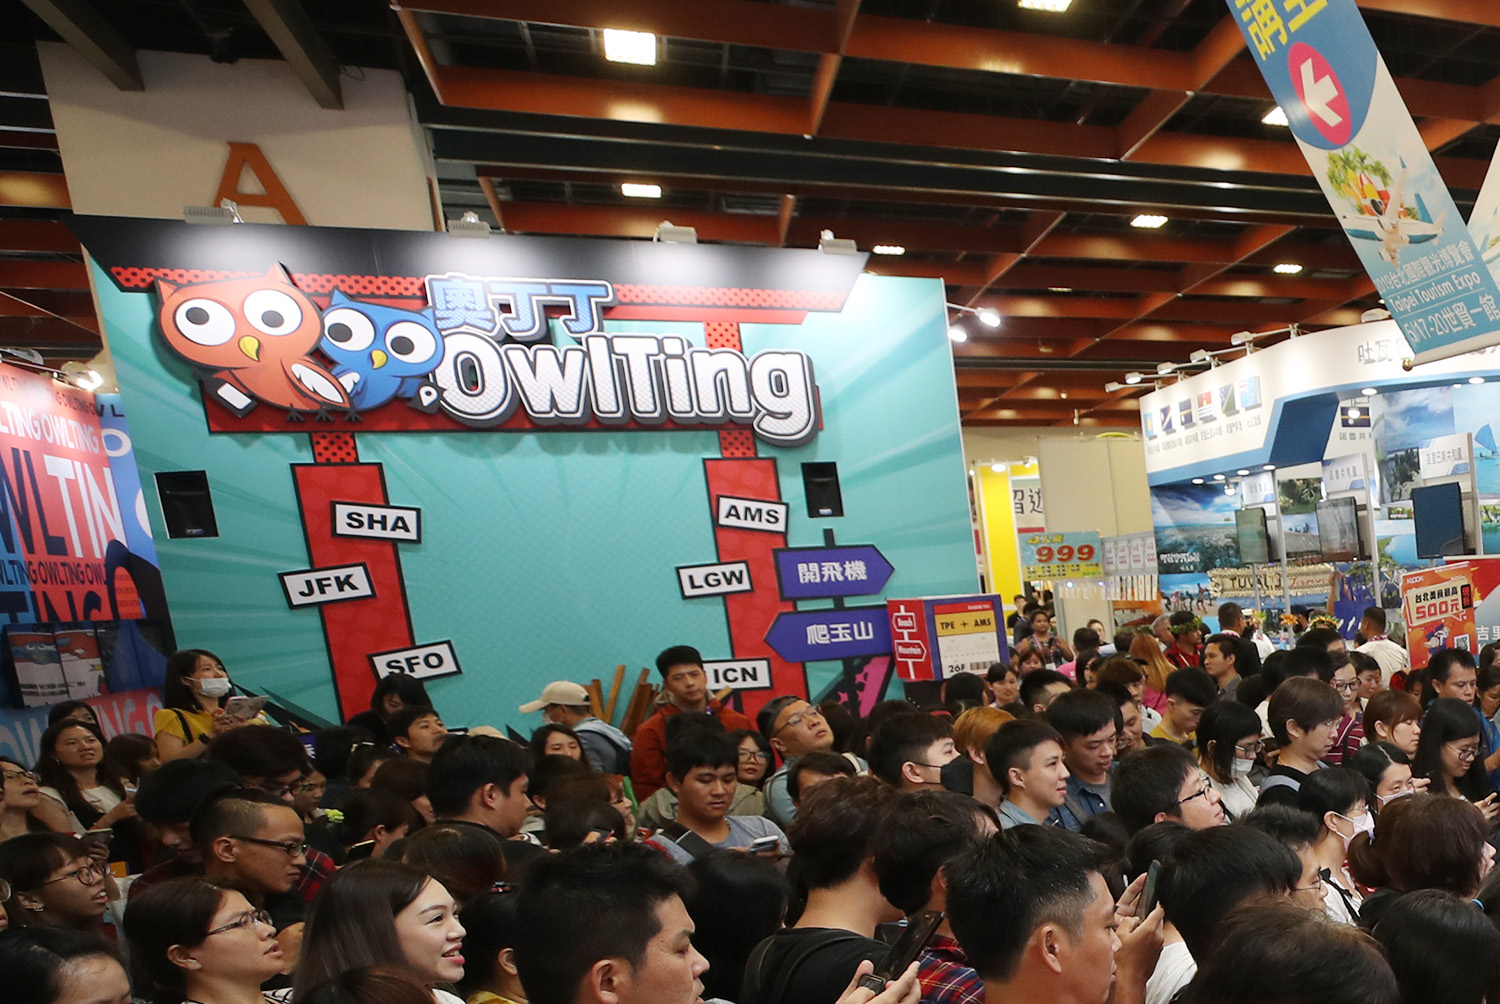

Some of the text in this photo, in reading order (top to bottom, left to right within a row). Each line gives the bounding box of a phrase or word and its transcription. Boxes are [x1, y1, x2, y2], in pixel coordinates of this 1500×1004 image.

[213, 143, 308, 225] A
[1388, 290, 1419, 313] Taipei
[1415, 281, 1455, 304] Tourism
[1451, 270, 1481, 291] Expo
[431, 278, 614, 336] 奧丁丁
[438, 328, 817, 444] OwlTing
[345, 510, 411, 534] SHA
[724, 504, 781, 526] AMS
[1035, 544, 1096, 564] 999
[688, 567, 745, 590] LGW
[798, 559, 868, 583] 開飛機
[298, 572, 359, 597] JFK
[1416, 600, 1460, 620] 500元
[806, 621, 875, 645] 爬玉山
[941, 618, 991, 630] TPE AMS
[384, 650, 445, 678] SFO
[713, 664, 759, 684] ICN
[948, 663, 965, 673] 26F
